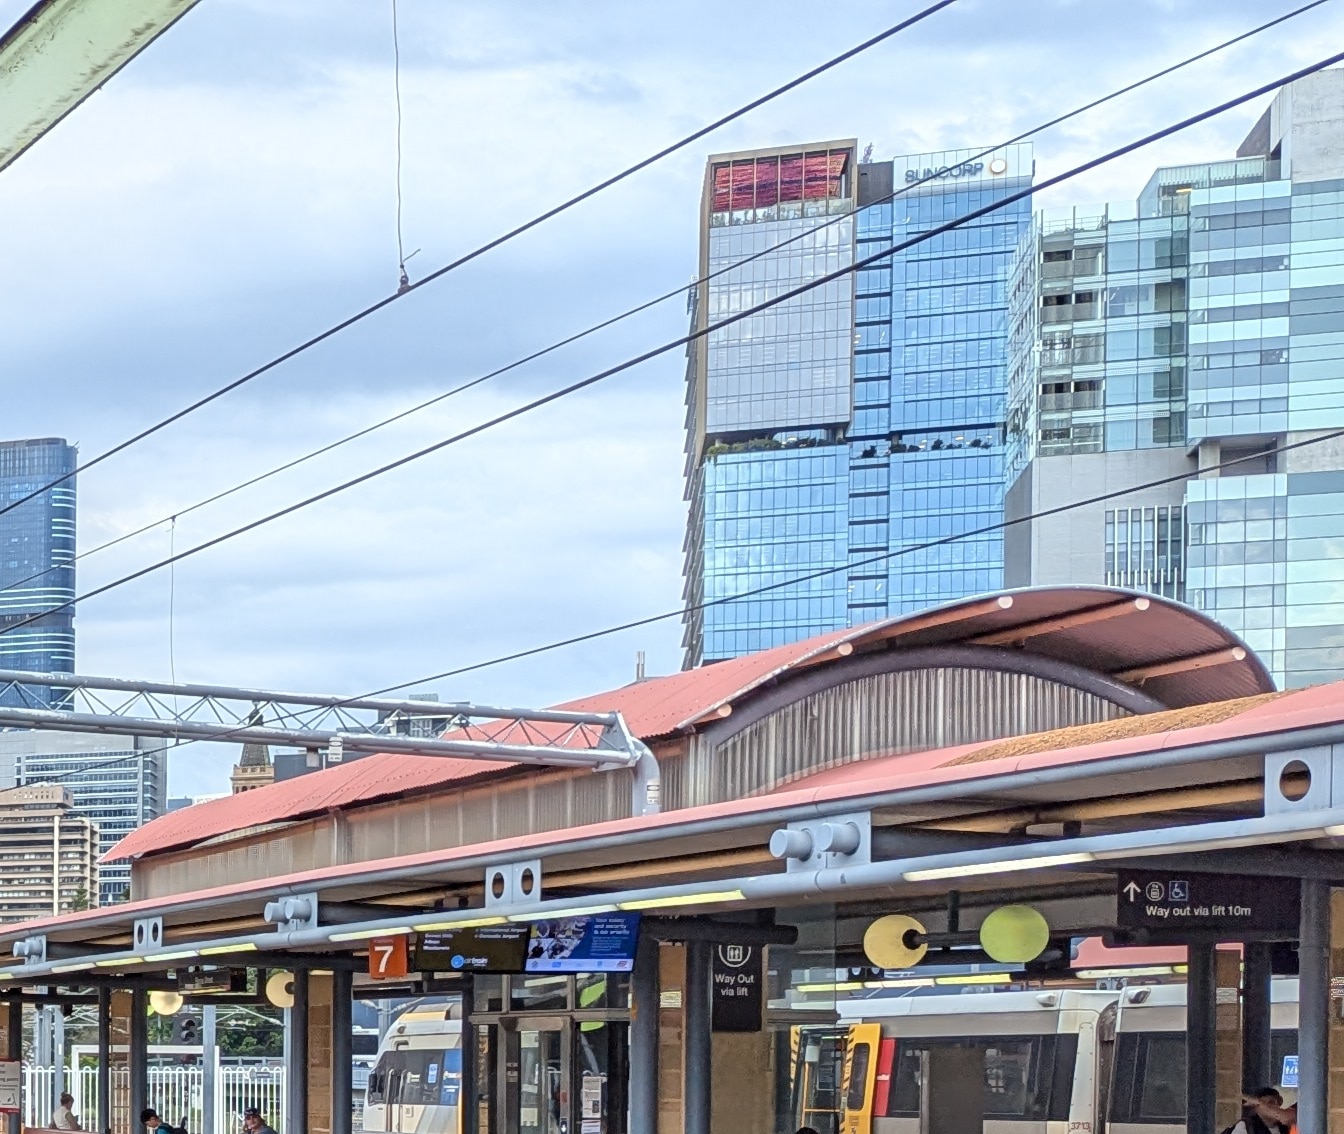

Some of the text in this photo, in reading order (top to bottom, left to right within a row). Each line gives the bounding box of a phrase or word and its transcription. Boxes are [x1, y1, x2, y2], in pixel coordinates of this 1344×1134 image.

[904, 162, 984, 182] SUNCORP
[1145, 905, 1252, 918] Way out via lift 10m
[375, 945, 393, 973] 7
[714, 973, 754, 985] Way Out
[721, 986, 748, 996] via lift
